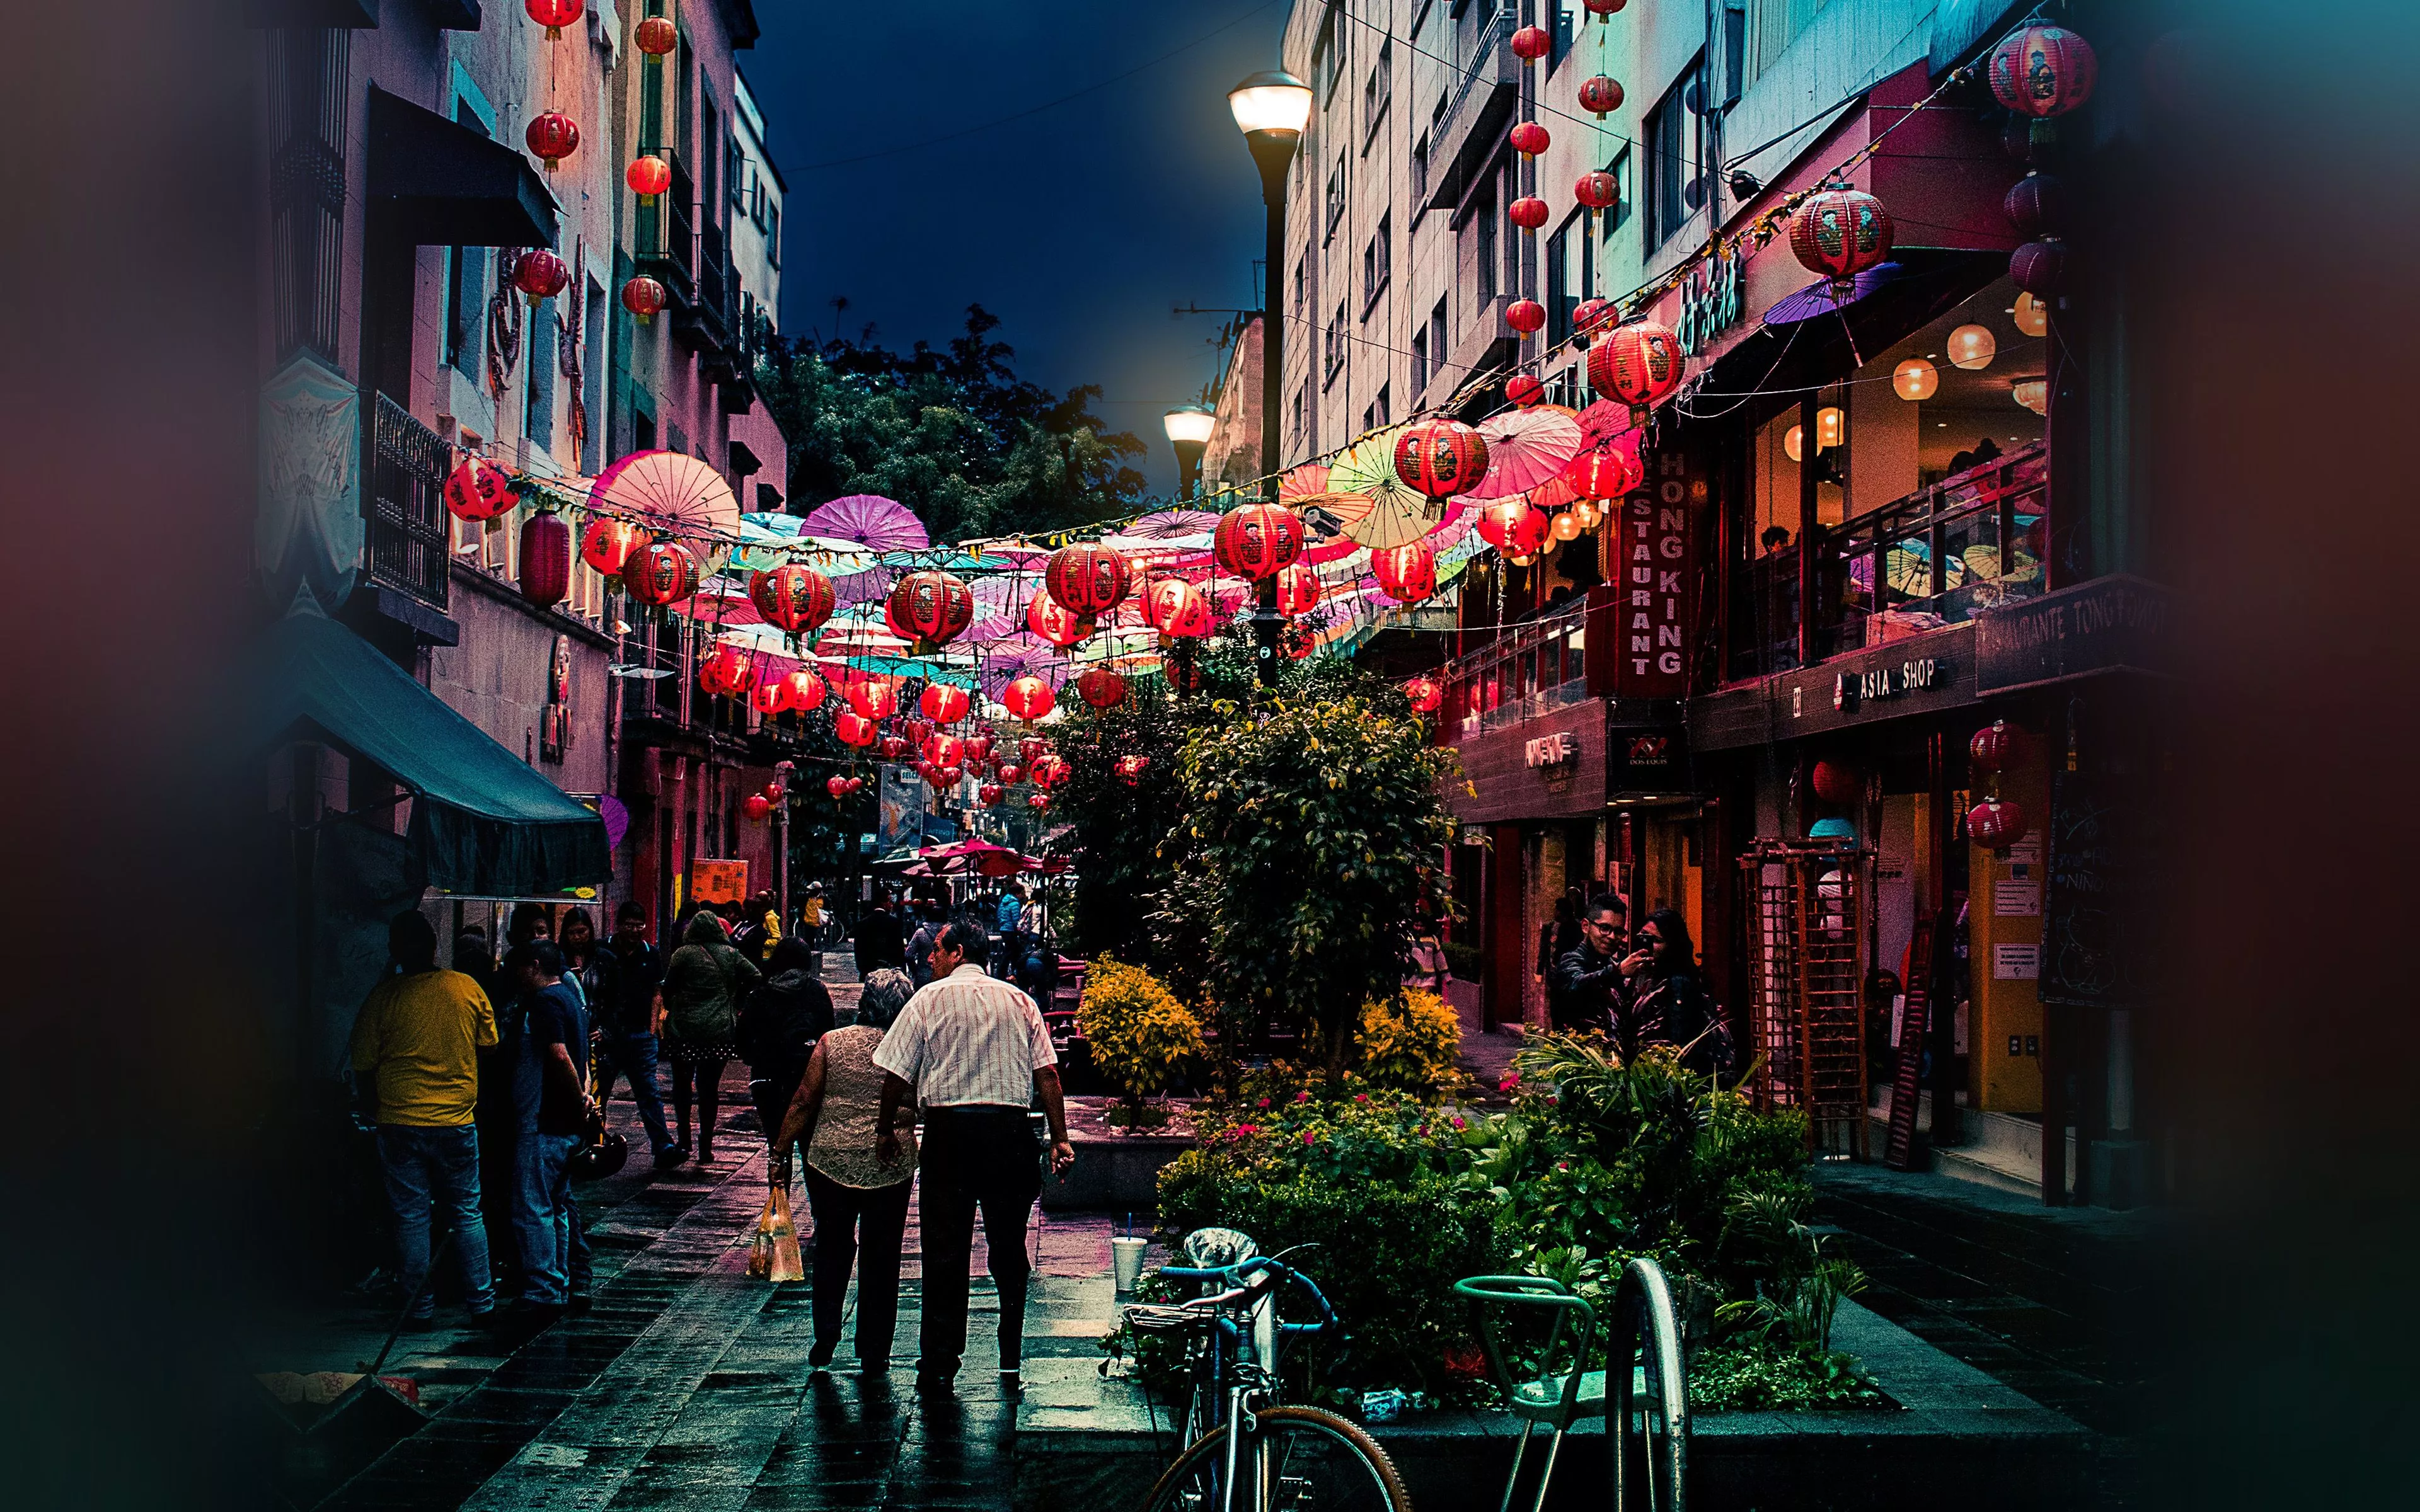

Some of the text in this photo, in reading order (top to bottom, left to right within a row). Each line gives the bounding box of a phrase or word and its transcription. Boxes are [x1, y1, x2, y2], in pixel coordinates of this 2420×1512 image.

[1658, 453, 1684, 673] HONG KING
[1860, 659, 1935, 699] ASIA SHOP
